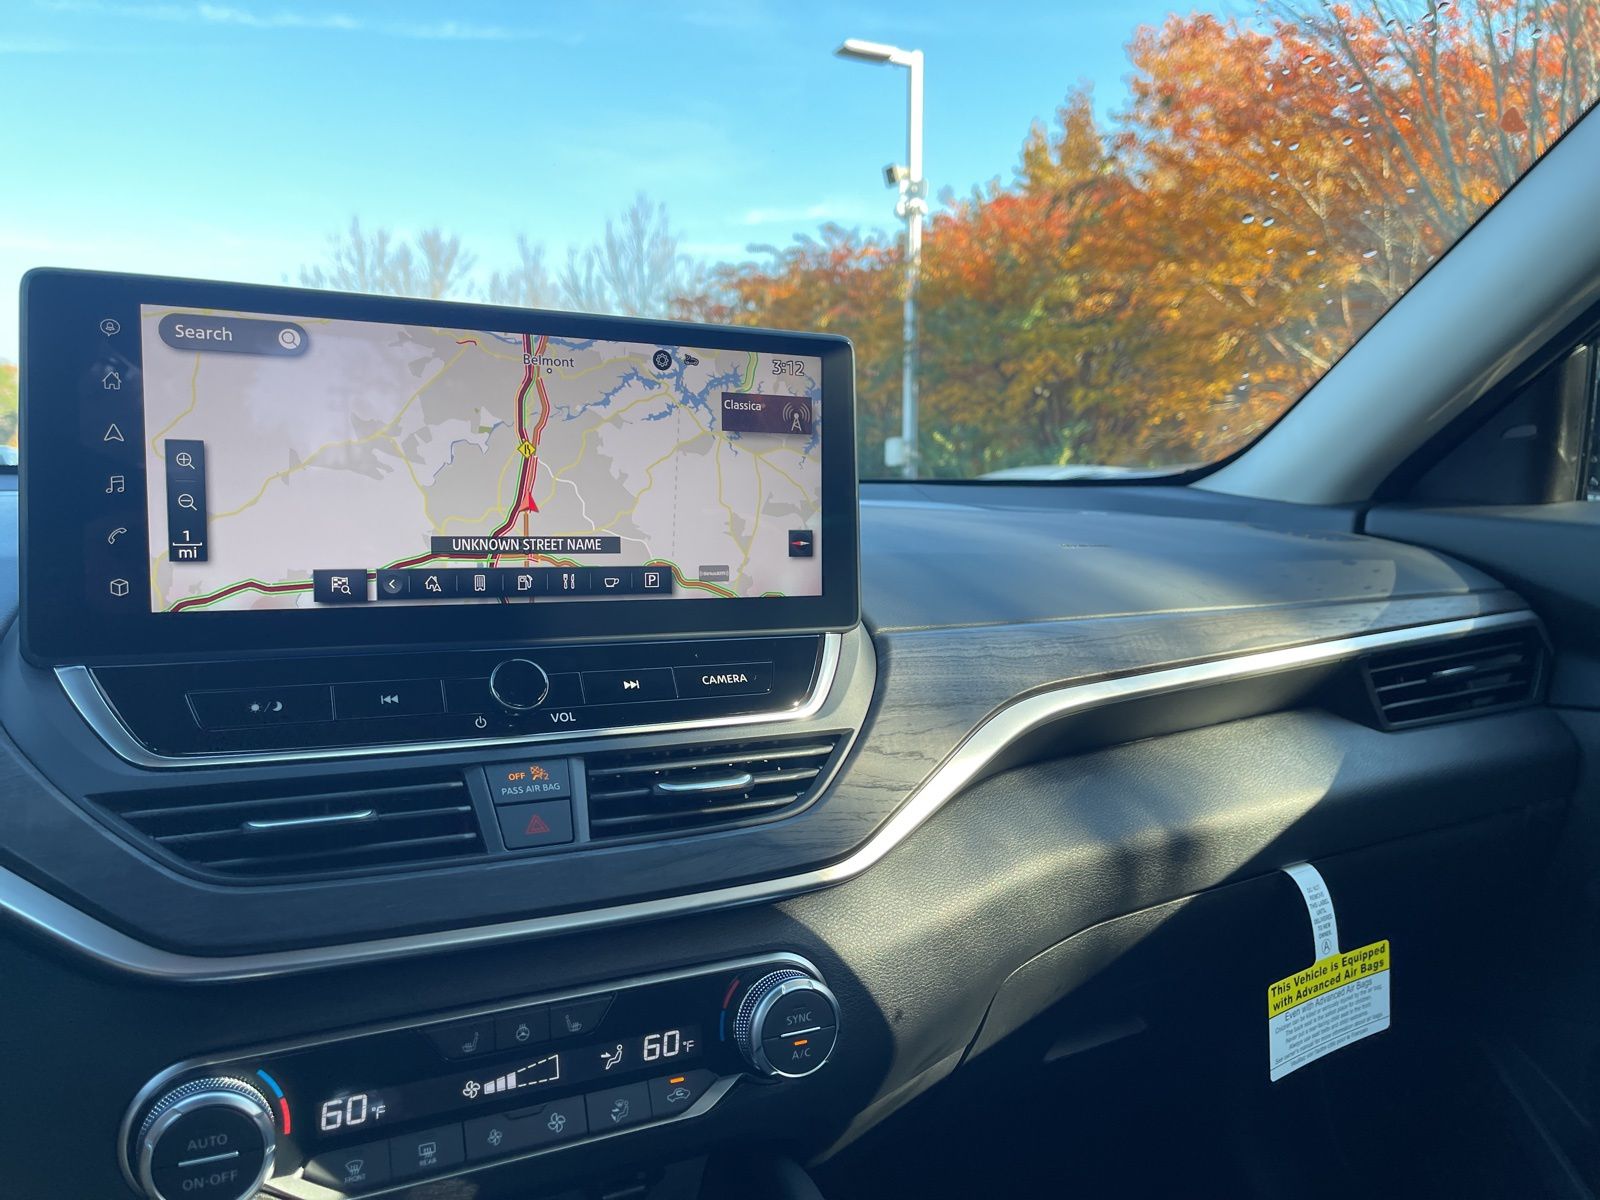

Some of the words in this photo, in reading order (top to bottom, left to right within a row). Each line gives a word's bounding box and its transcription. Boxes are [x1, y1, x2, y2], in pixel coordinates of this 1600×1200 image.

[175, 324, 233, 342] Search
[523, 353, 575, 368] Belmont
[771, 359, 805, 377] 3:12
[182, 530, 191, 541] 1
[451, 538, 520, 552] UNKNOWN
[522, 538, 564, 551] STREET
[566, 537, 602, 551] NAME
[177, 547, 198, 559] mi
[702, 673, 748, 685] CAMERA
[550, 711, 577, 724] VOL
[508, 771, 526, 781] OFF
[501, 786, 524, 796] PASS
[525, 784, 541, 793] AIR
[542, 782, 561, 792] BAG
[1271, 982, 1291, 998] This
[1293, 965, 1328, 987] Vehicle
[1330, 960, 1339, 972] is
[1341, 943, 1386, 967] Equipped
[1273, 994, 1293, 1012] with
[1296, 972, 1341, 1001] Advanced
[1344, 967, 1358, 980] Air
[1360, 959, 1384, 973] Bags
[786, 1011, 813, 1026] SYNC
[792, 1047, 811, 1060] A/C
[188, 1133, 229, 1151] AUTO
